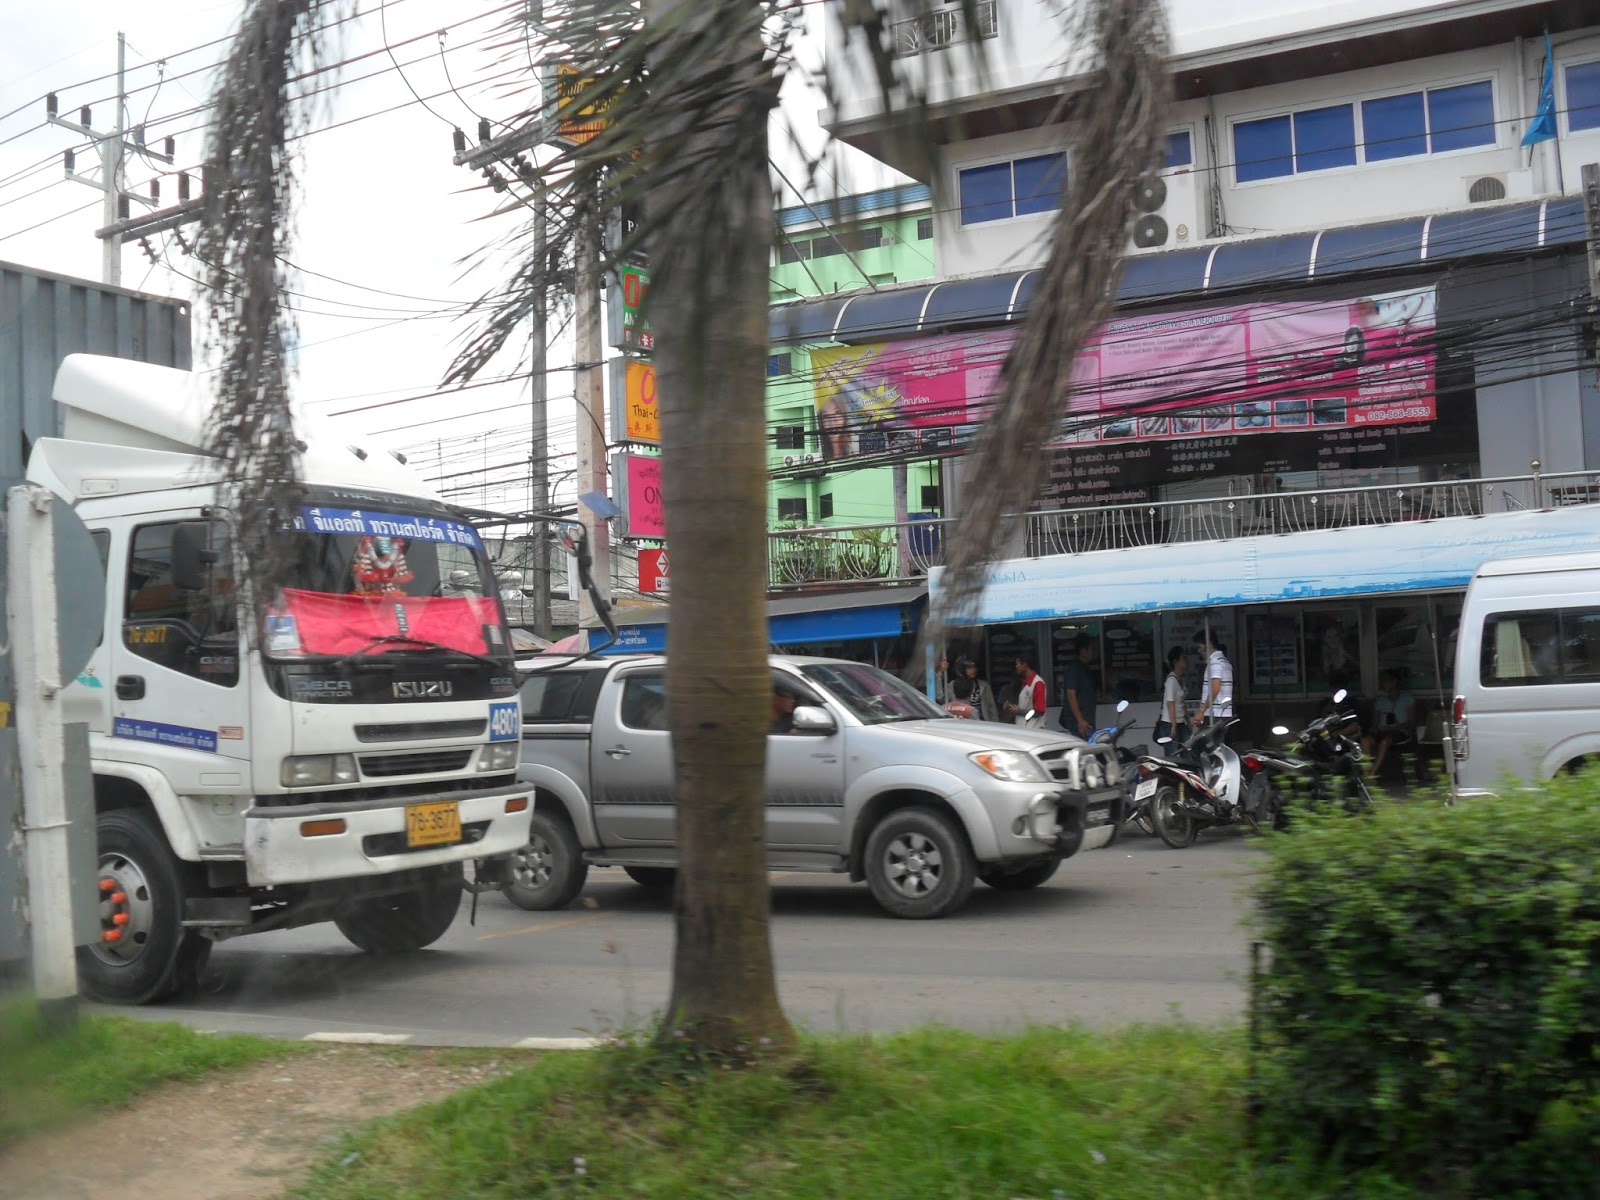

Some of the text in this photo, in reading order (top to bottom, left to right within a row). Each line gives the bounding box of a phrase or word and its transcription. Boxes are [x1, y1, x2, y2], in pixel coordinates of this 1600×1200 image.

[1367, 406, 1431, 421] 082-868-8558
[392, 681, 453, 699] ISUZU
[491, 707, 518, 736] 4801
[409, 808, 455, 832] 76-3677
